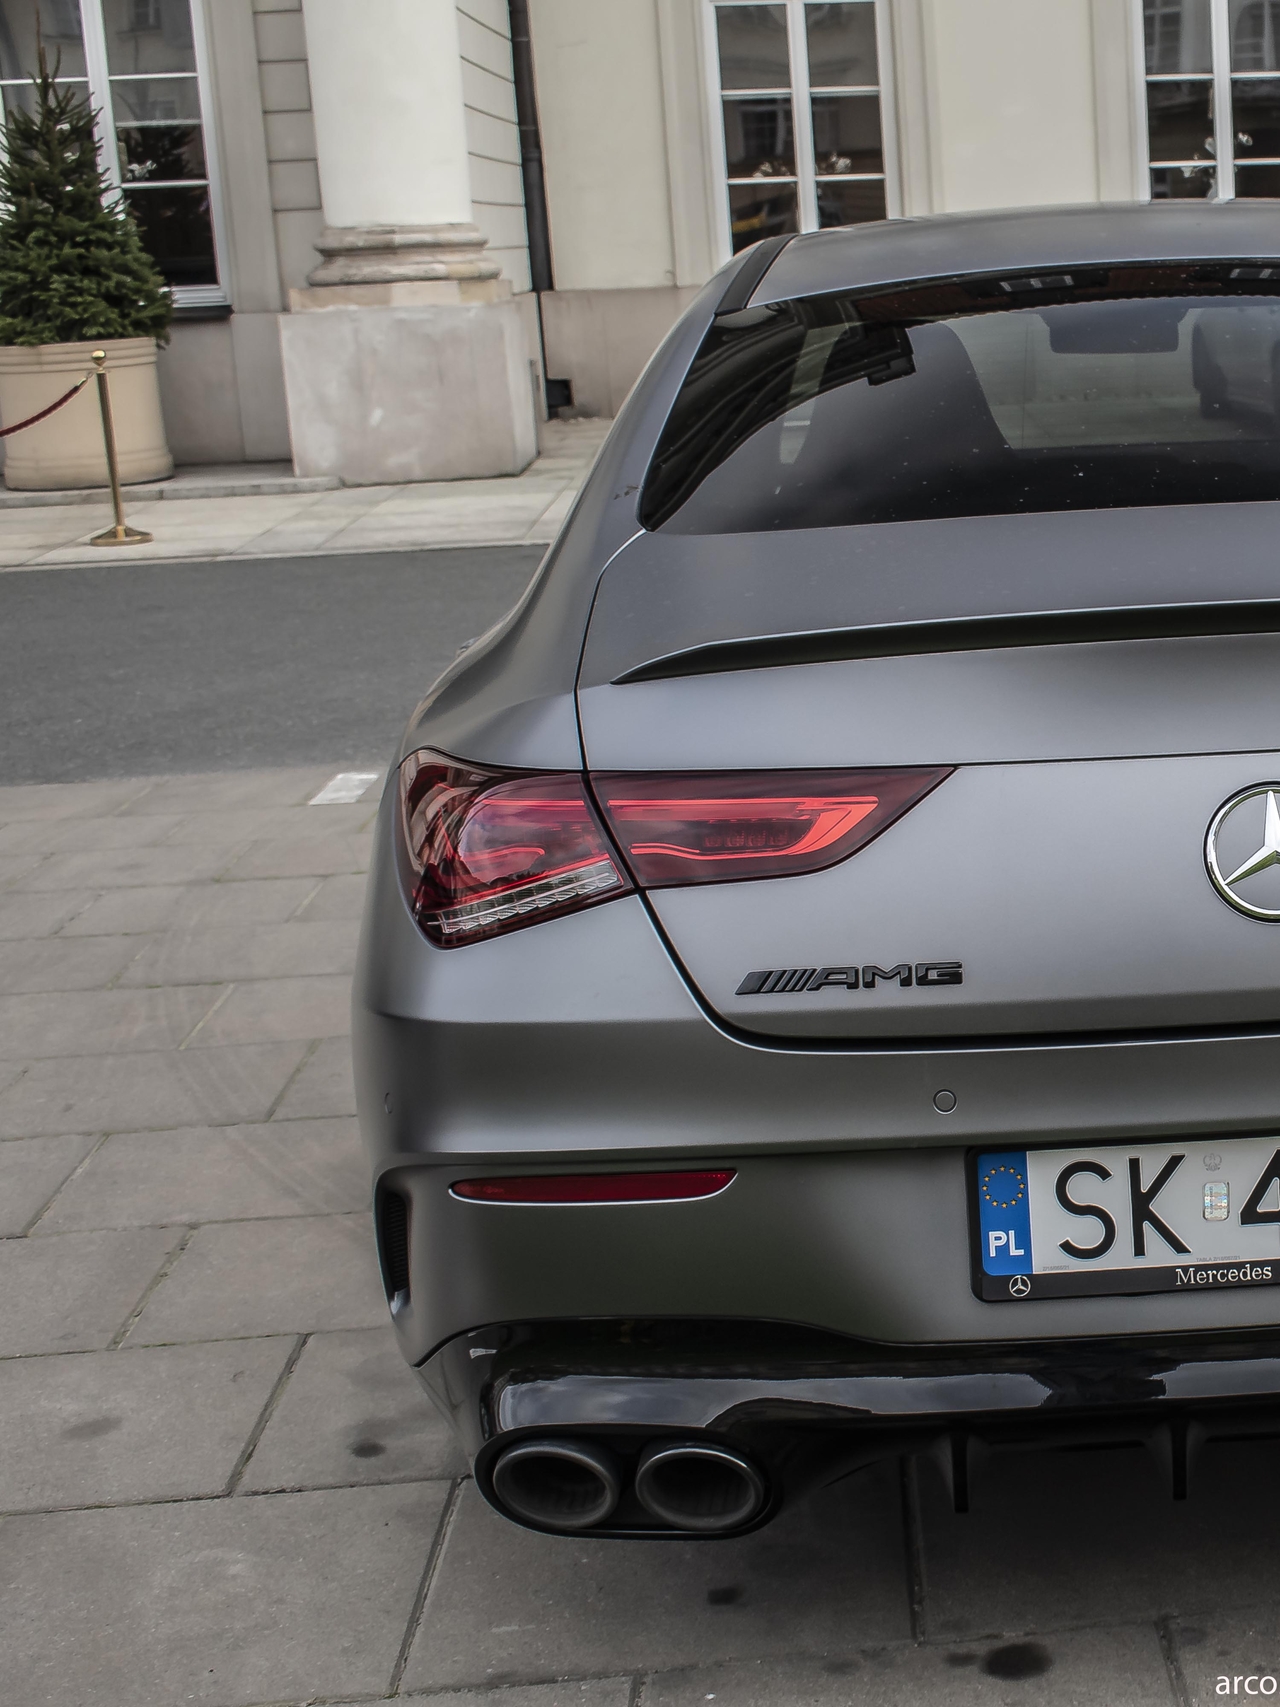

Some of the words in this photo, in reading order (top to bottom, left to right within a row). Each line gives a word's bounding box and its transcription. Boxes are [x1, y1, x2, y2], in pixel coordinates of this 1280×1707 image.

[805, 961, 965, 992] AMG
[1054, 1151, 1194, 1260] SK
[987, 1229, 1026, 1258] PL
[1175, 1262, 1273, 1286] Mercedes
